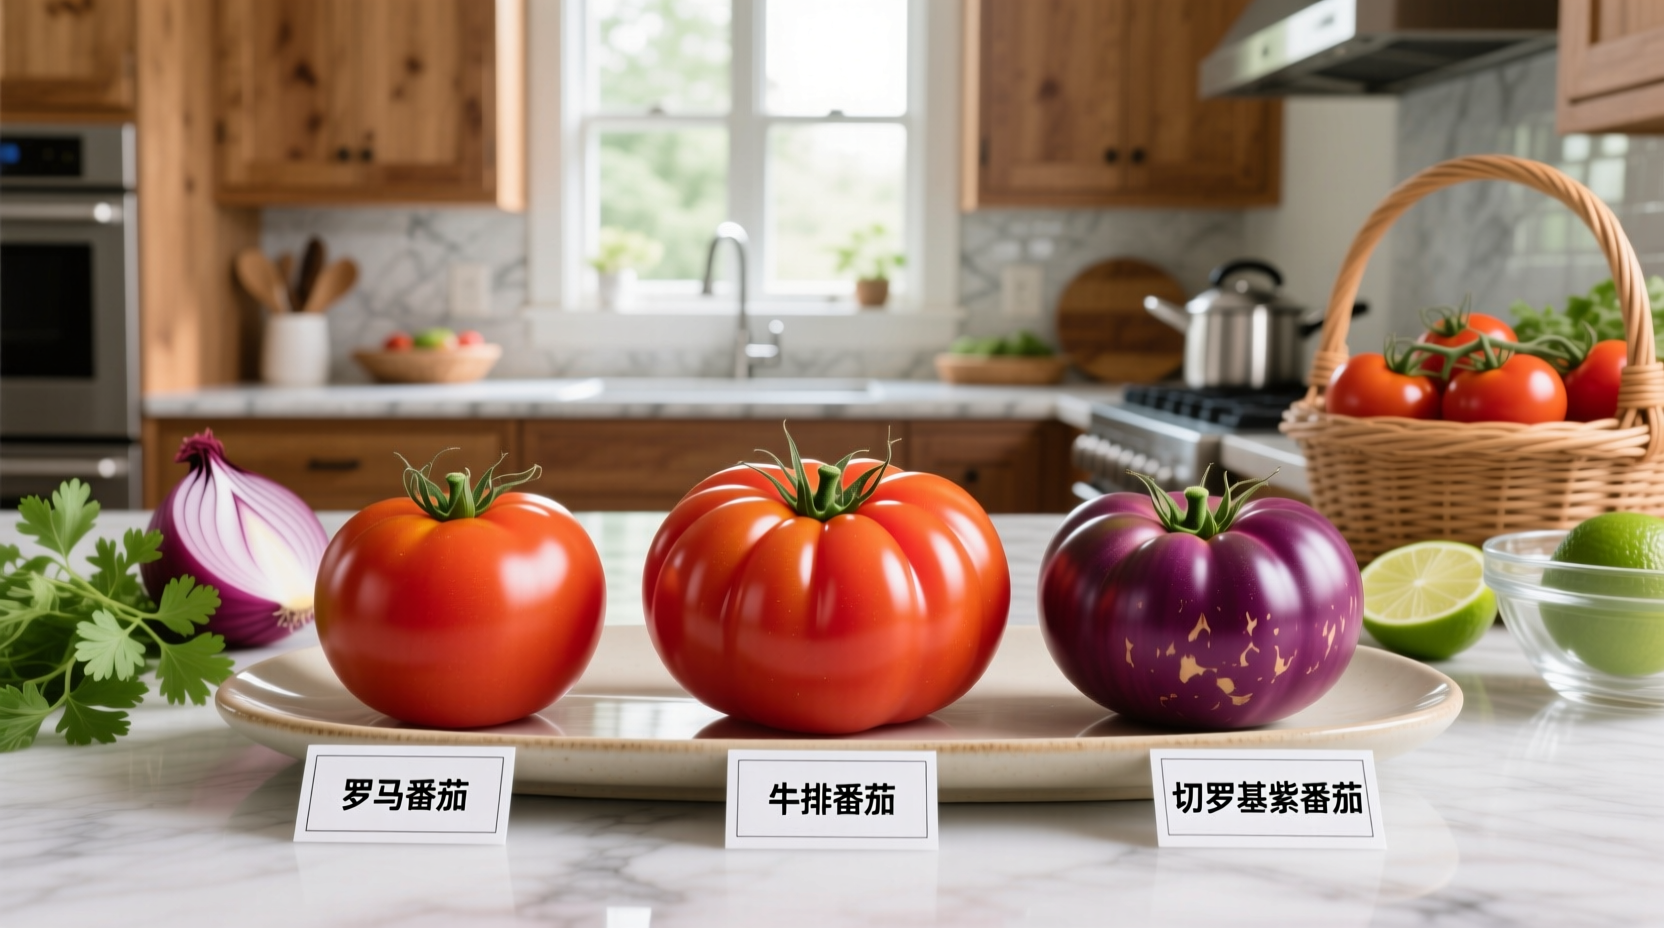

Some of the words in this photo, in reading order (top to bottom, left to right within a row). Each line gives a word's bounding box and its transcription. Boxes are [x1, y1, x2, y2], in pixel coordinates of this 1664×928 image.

[342, 778, 470, 812] 罗马番茄
[768, 781, 896, 816] 牛排番茄
[1172, 780, 1363, 815] 切罗基紫番茄
